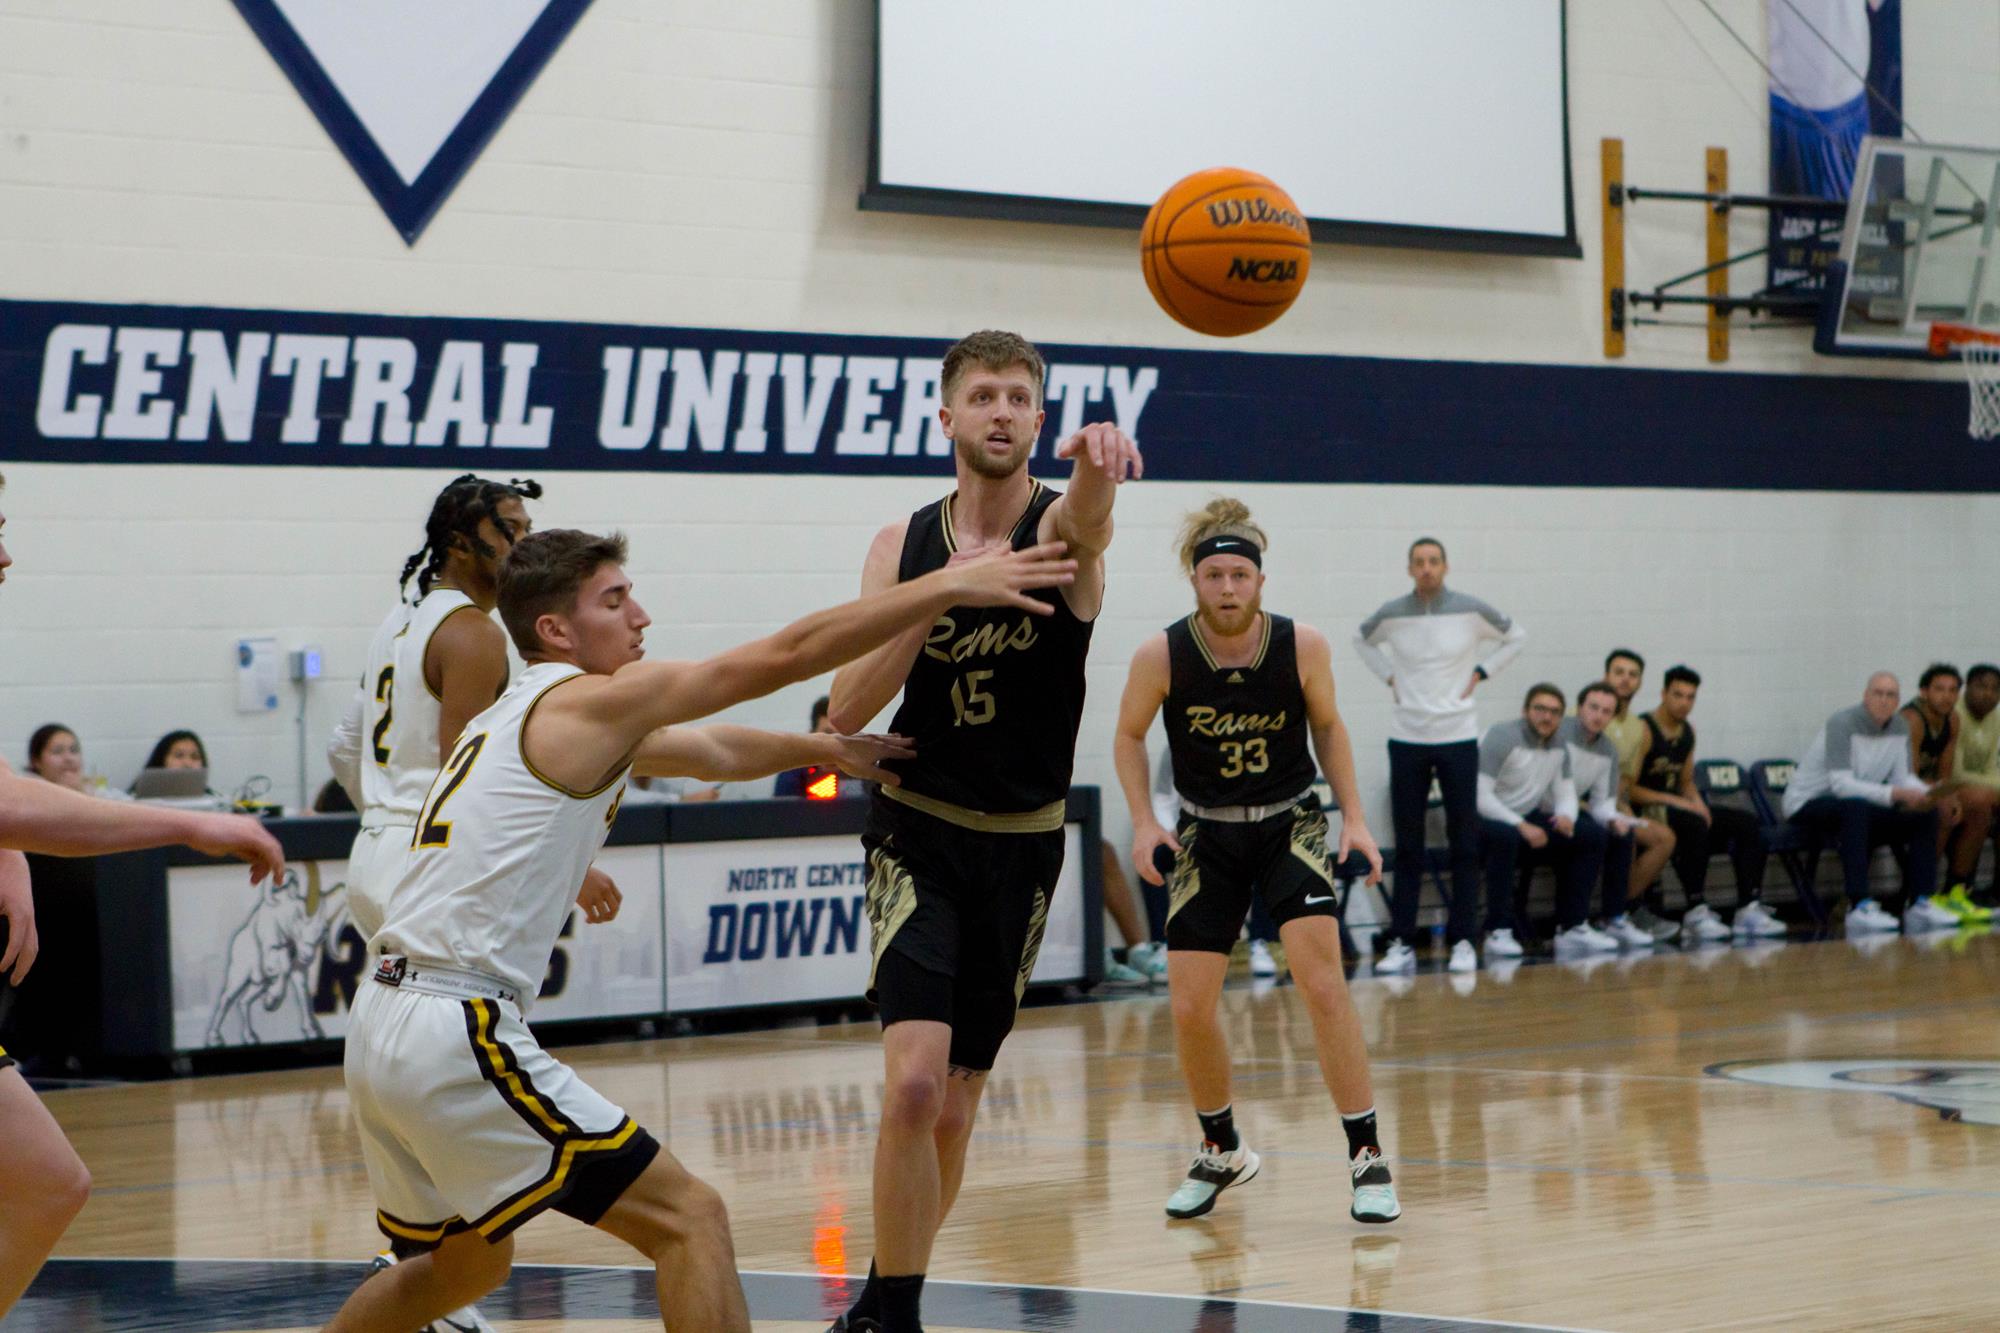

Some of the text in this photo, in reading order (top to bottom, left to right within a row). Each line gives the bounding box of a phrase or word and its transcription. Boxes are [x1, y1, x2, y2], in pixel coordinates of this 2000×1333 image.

[1207, 198, 1305, 234] Wilson
[1227, 257, 1298, 282] NCAA
[36, 323, 1160, 459] CENTRAL UNIVERTY
[372, 663, 395, 768] 2
[951, 669, 996, 727] 15
[1186, 705, 1287, 737] Rams
[1219, 736, 1270, 779] 33
[727, 866, 799, 893] NORTH
